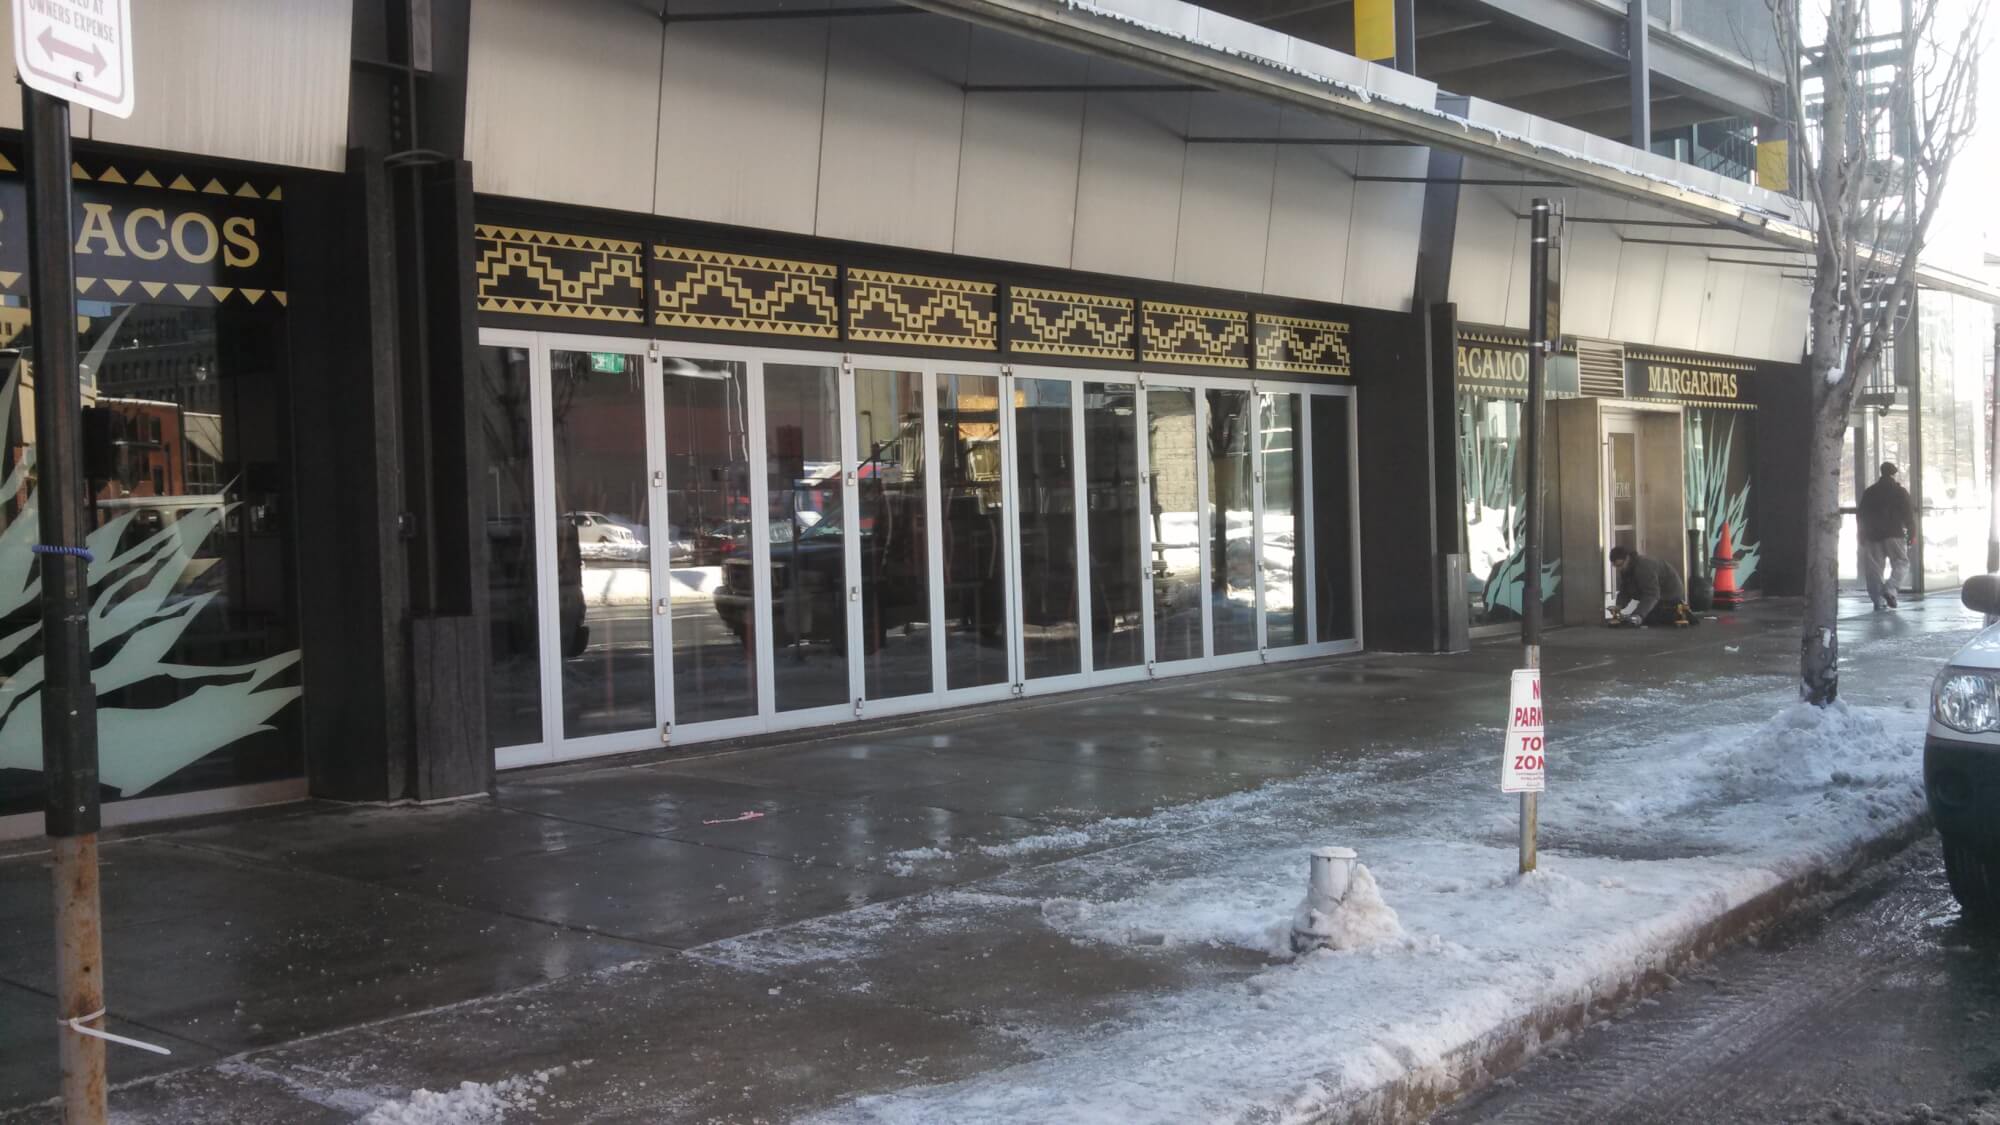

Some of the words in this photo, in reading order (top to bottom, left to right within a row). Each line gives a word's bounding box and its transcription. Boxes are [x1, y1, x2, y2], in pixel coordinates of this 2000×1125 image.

[29, 0, 71, 24] OWNERS
[73, 11, 115, 43] EXPENSE
[75, 203, 260, 268] ACOS
[1457, 346, 1547, 383] ACAMO
[1648, 366, 1738, 398] MARGARITAS
[1532, 679, 1541, 700] N
[1521, 736, 1545, 751] TO
[1514, 755, 1545, 770] ZON
